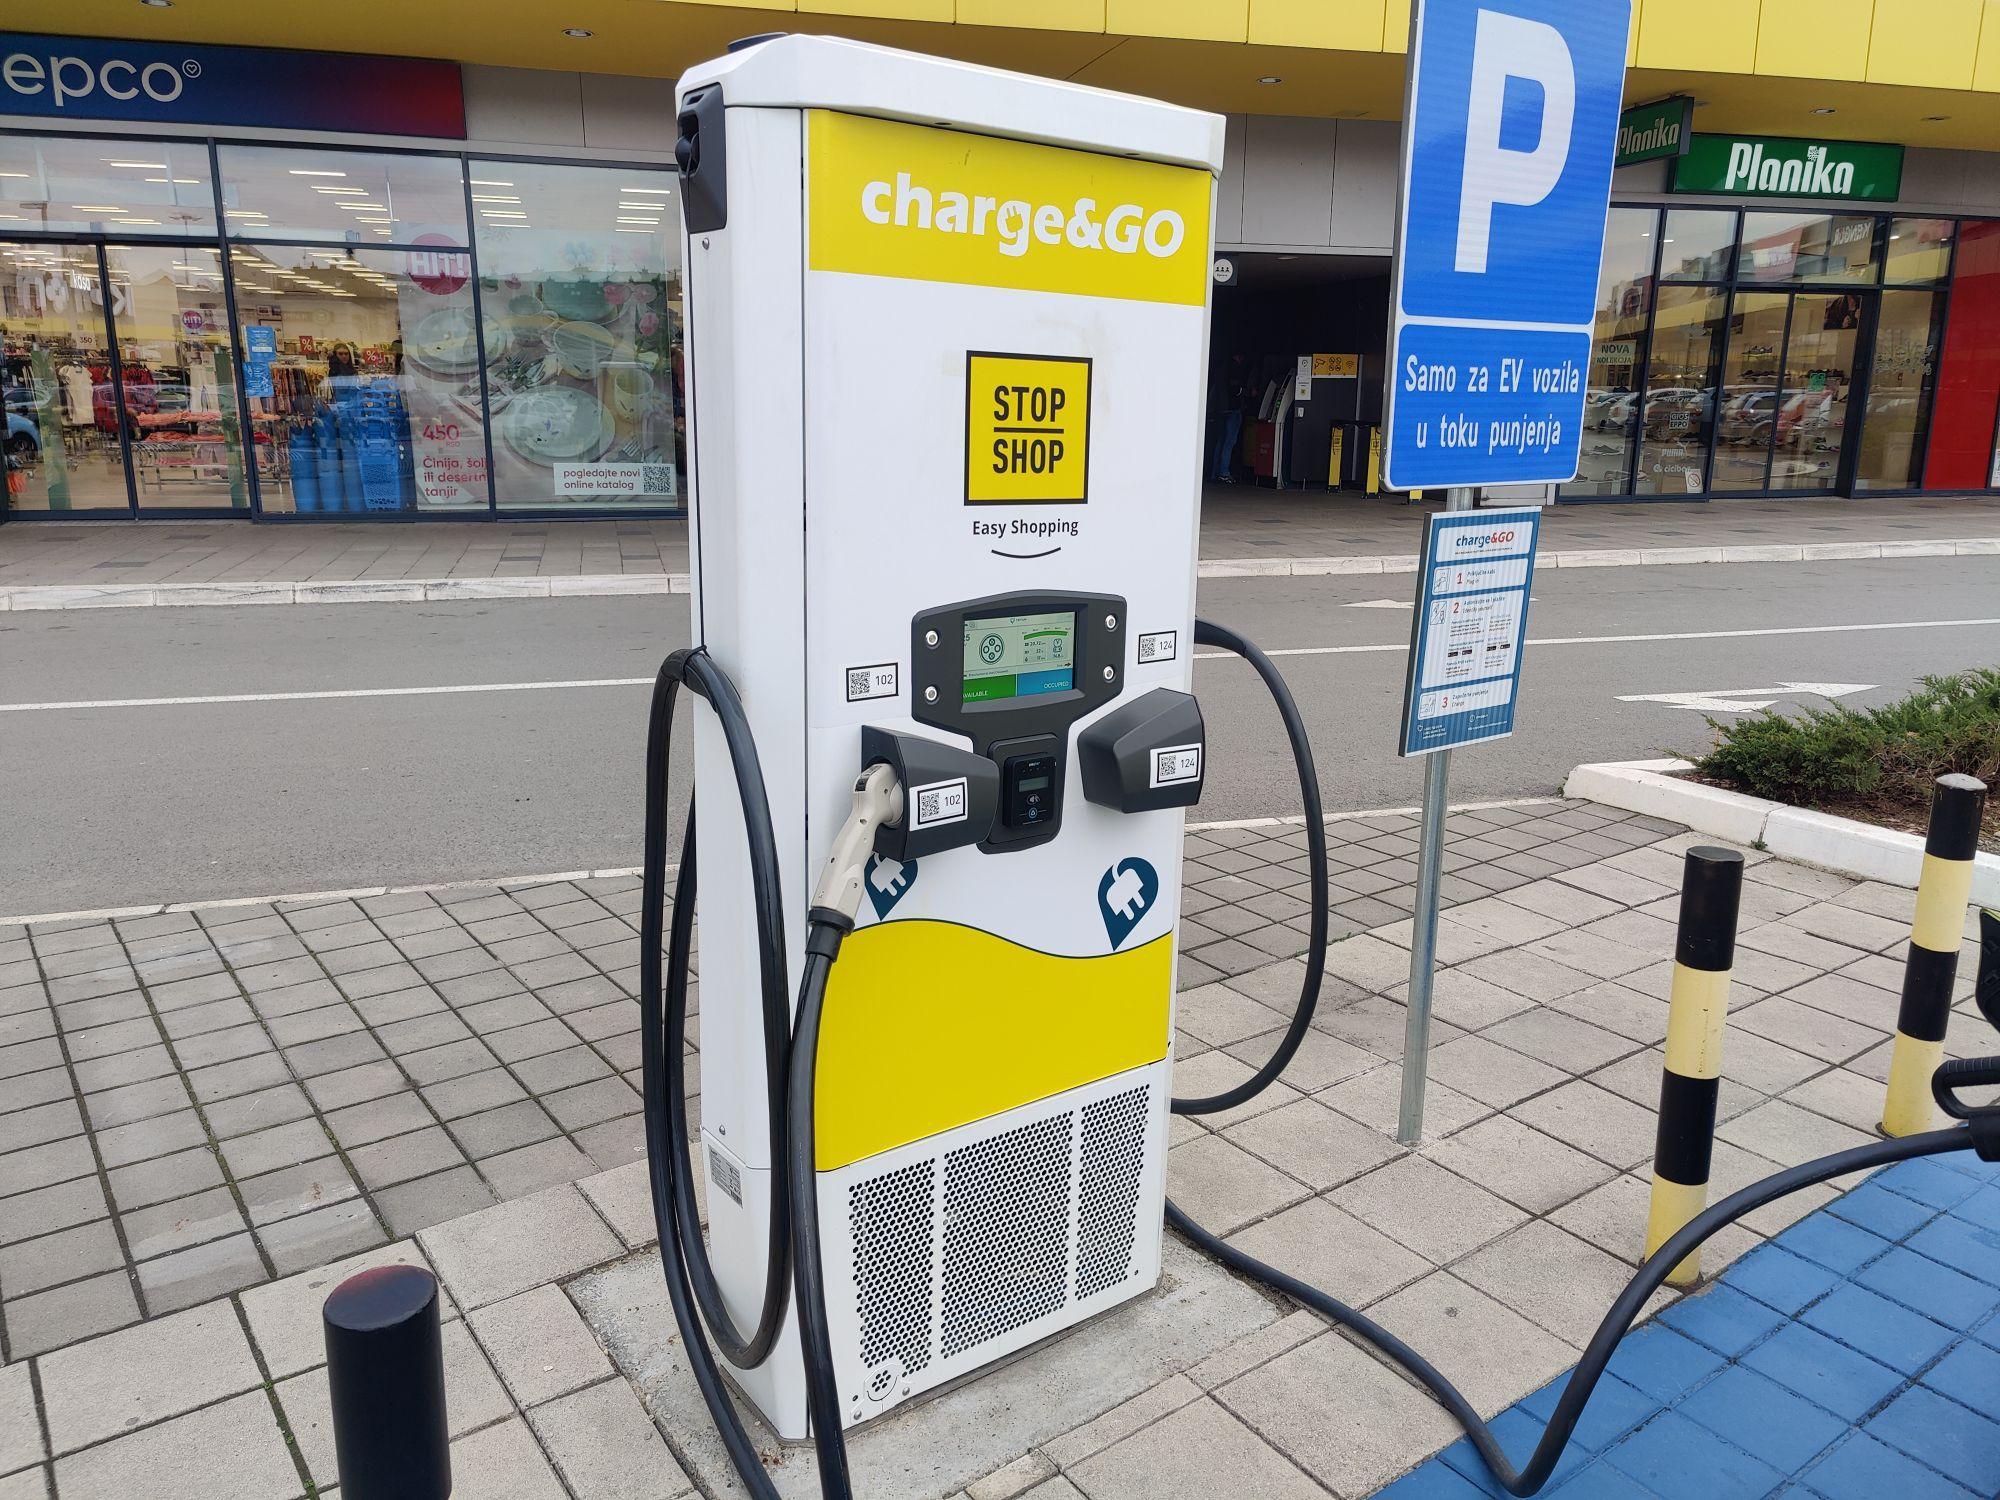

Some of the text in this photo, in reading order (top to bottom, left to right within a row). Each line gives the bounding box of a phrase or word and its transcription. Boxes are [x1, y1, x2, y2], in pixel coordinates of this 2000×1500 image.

[1454, 8, 1576, 274] P
[1615, 117, 1680, 157] Planika
[1724, 142, 1855, 194] Planika
[861, 172, 1185, 258] charge&GO
[1601, 344, 1630, 354] NOVA
[1405, 354, 1580, 393] Samo za EV vozila
[993, 385, 1066, 423] STOP
[422, 424, 461, 441] 450
[1416, 413, 1562, 455] u toku punjenja
[992, 438, 1065, 474] SHOP
[424, 472, 434, 482] ili
[563, 468, 640, 479] pogledajte novi
[564, 479, 634, 490] online katalog
[425, 486, 458, 498] tanjir
[973, 519, 1079, 539] Easy Shopping
[1456, 531, 1515, 548] charge&GO
[1457, 572, 1463, 584] 1
[1453, 602, 1460, 614] 2
[1159, 639, 1173, 650] 124
[875, 674, 894, 686] 102
[1441, 696, 1449, 709] 3
[1180, 758, 1195, 769] 124
[944, 794, 961, 807] 102
